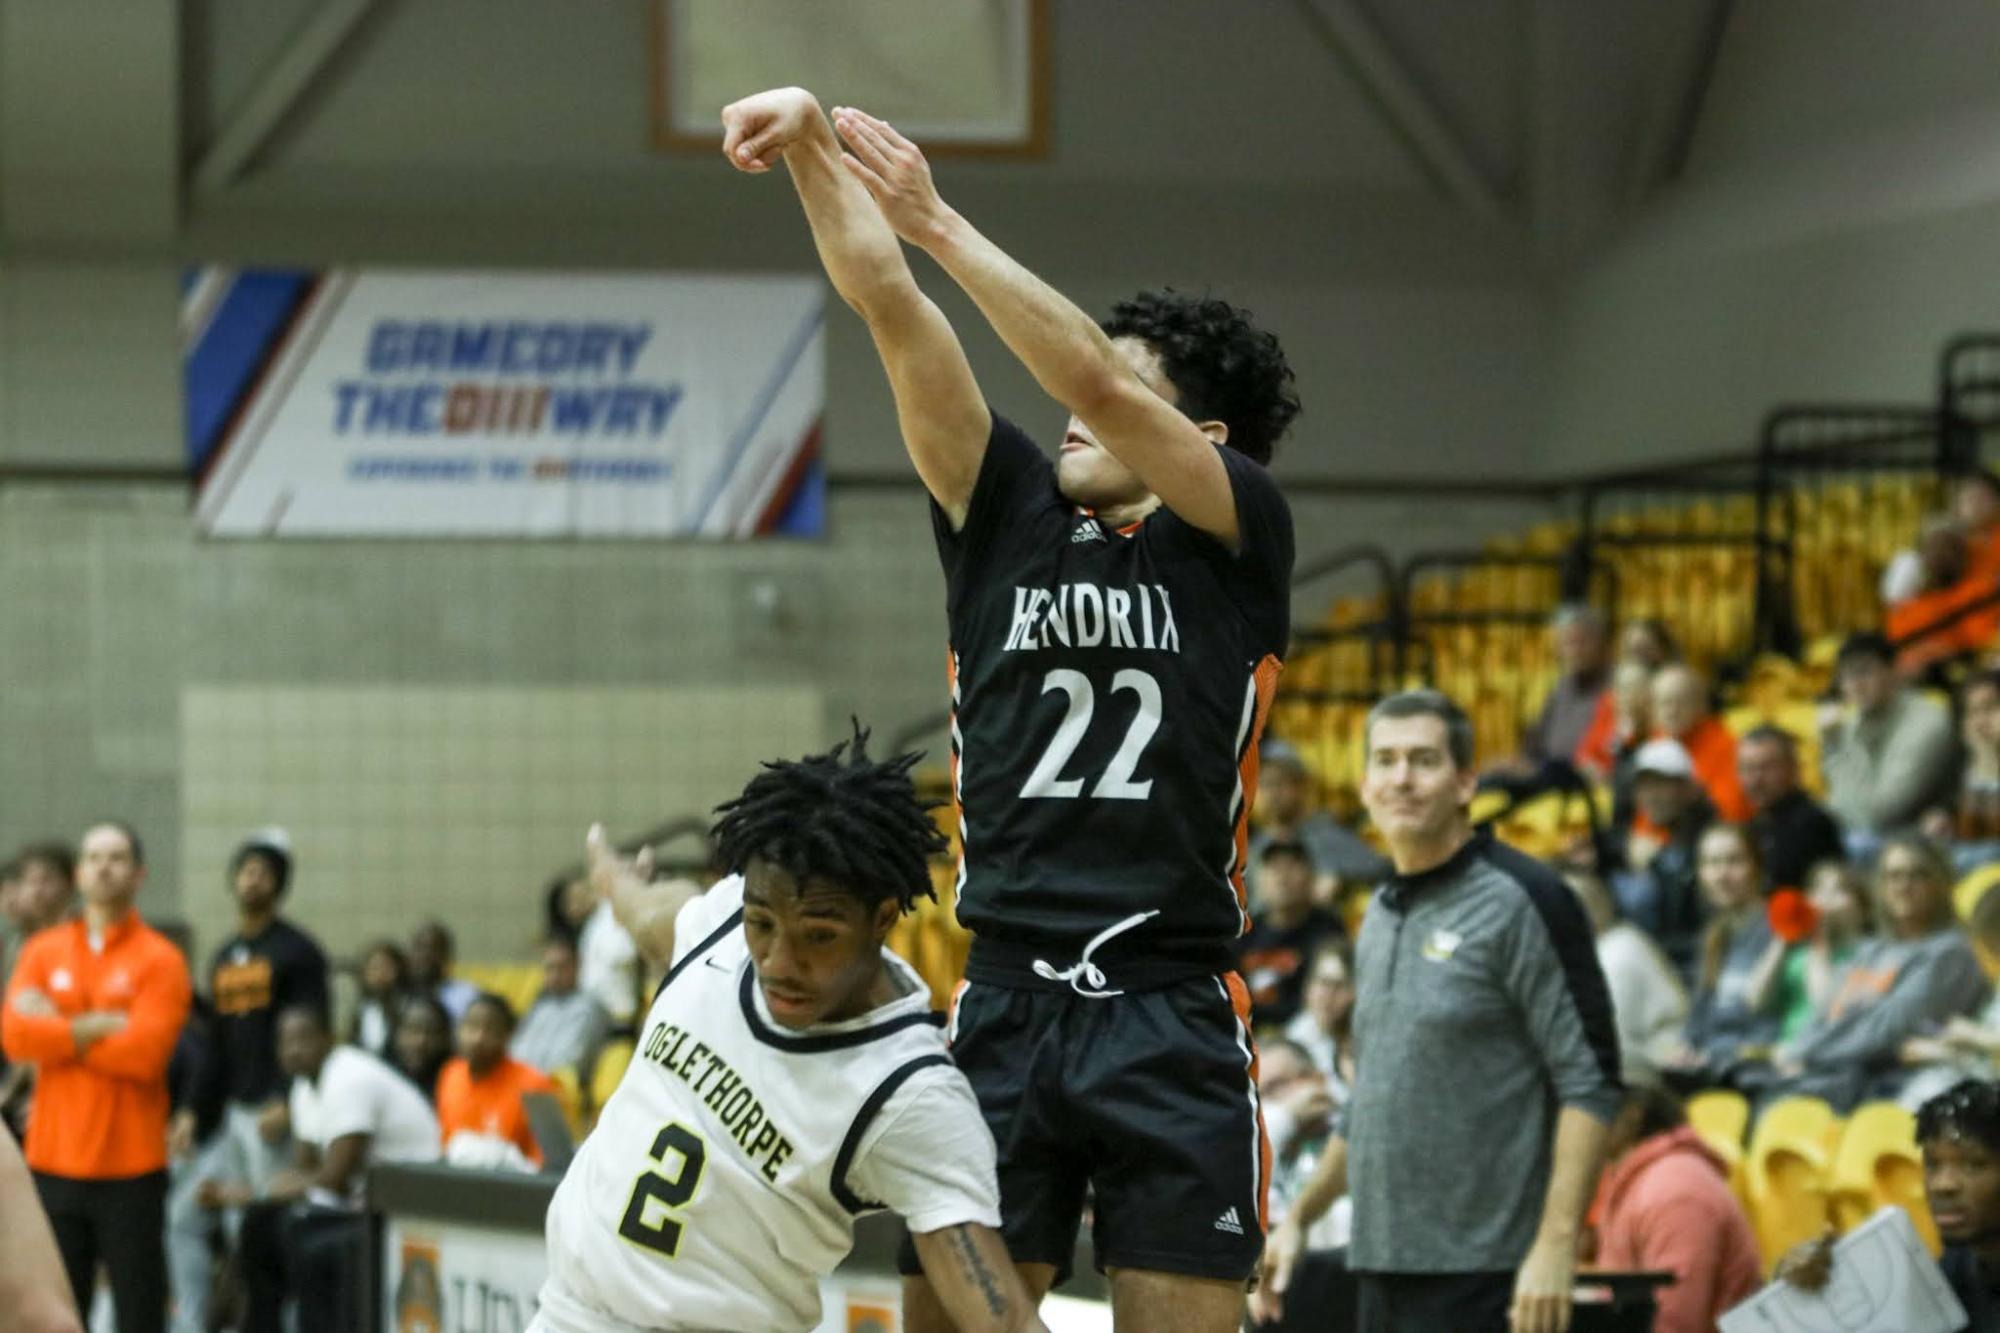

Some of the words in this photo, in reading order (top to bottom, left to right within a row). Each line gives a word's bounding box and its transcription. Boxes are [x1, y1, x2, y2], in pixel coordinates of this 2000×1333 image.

[1003, 582, 1181, 653] HENDRIX
[1018, 668, 1162, 800] 22
[643, 1021, 794, 1183] OGLETHORPE
[617, 1121, 707, 1259] 2
